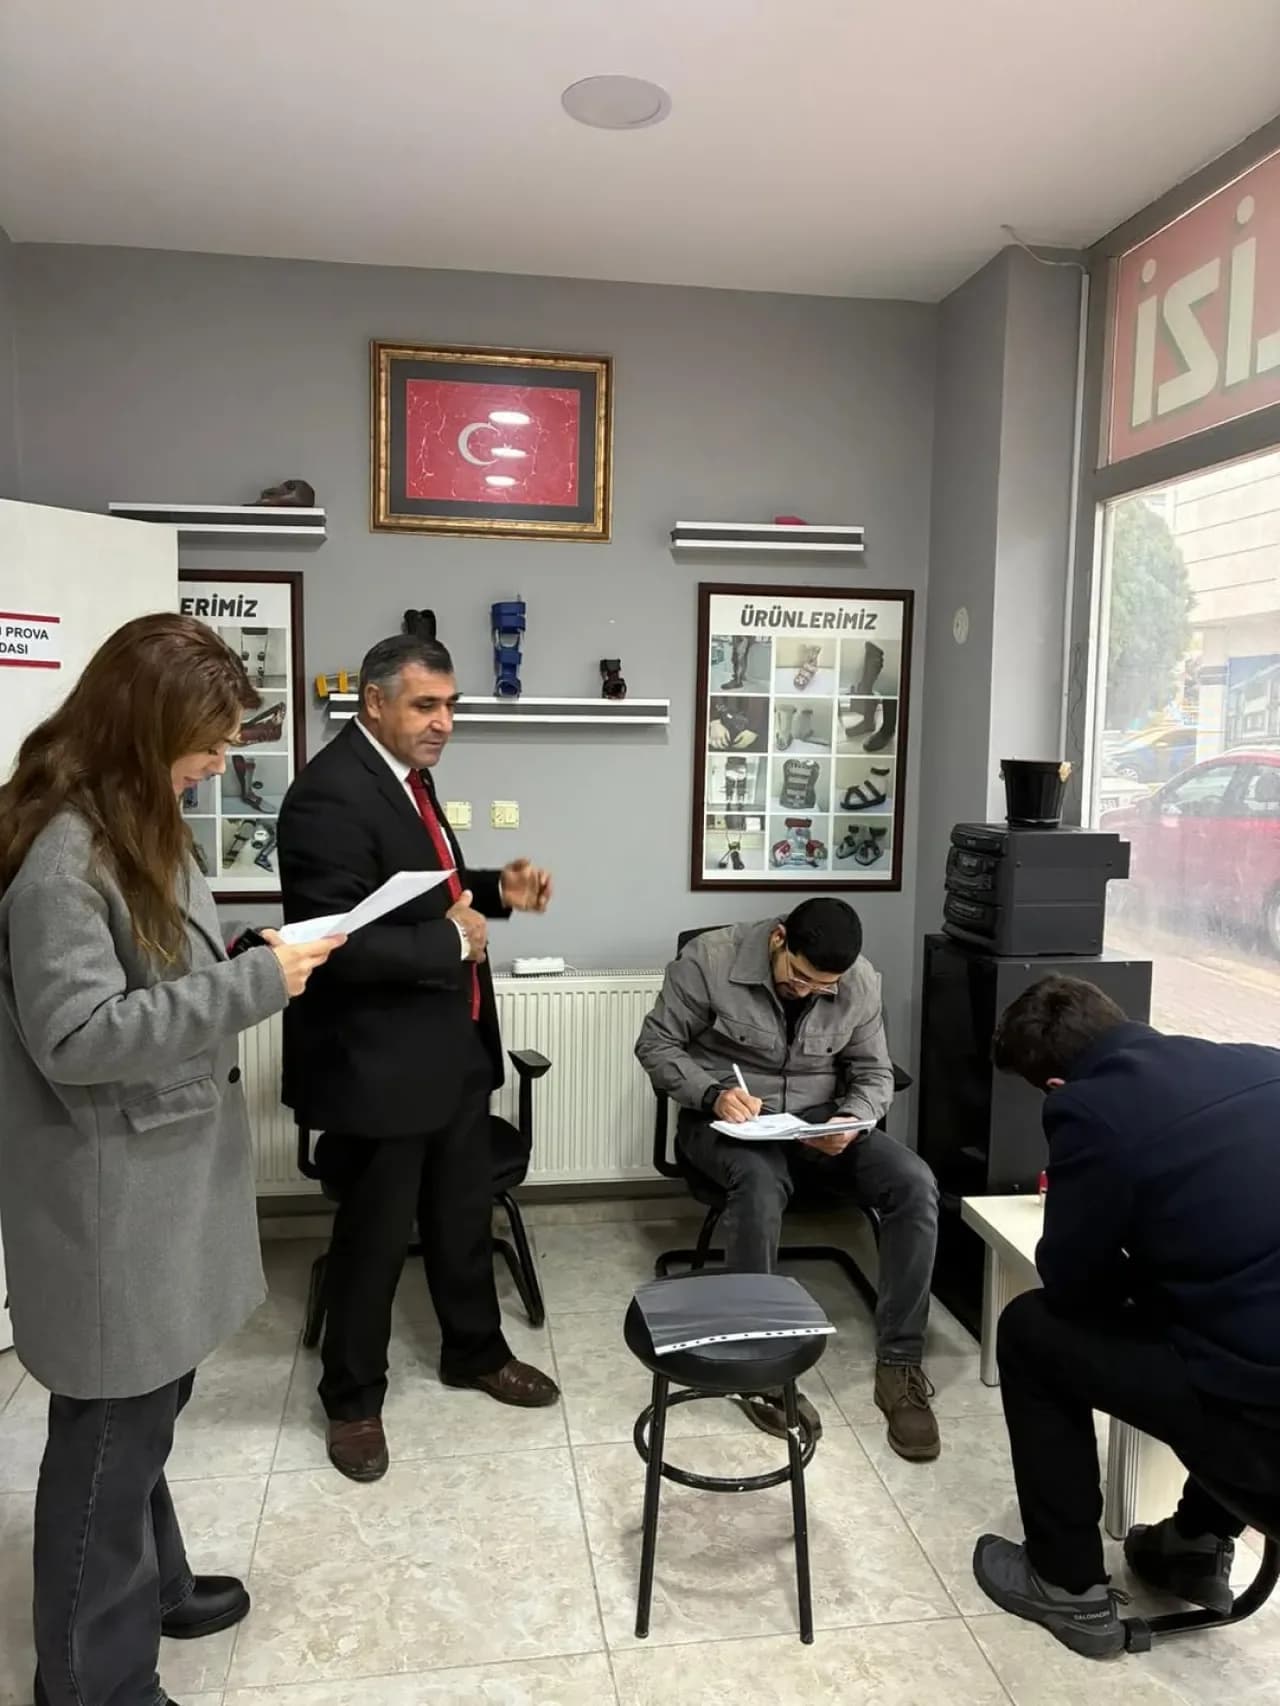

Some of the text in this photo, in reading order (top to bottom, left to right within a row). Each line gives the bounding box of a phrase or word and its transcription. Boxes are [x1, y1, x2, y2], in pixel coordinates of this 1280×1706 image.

[180, 593, 258, 617] ERİMİZ
[741, 604, 878, 630] ÜRÜNLERİMİZ
[5, 626, 49, 640] PROVA
